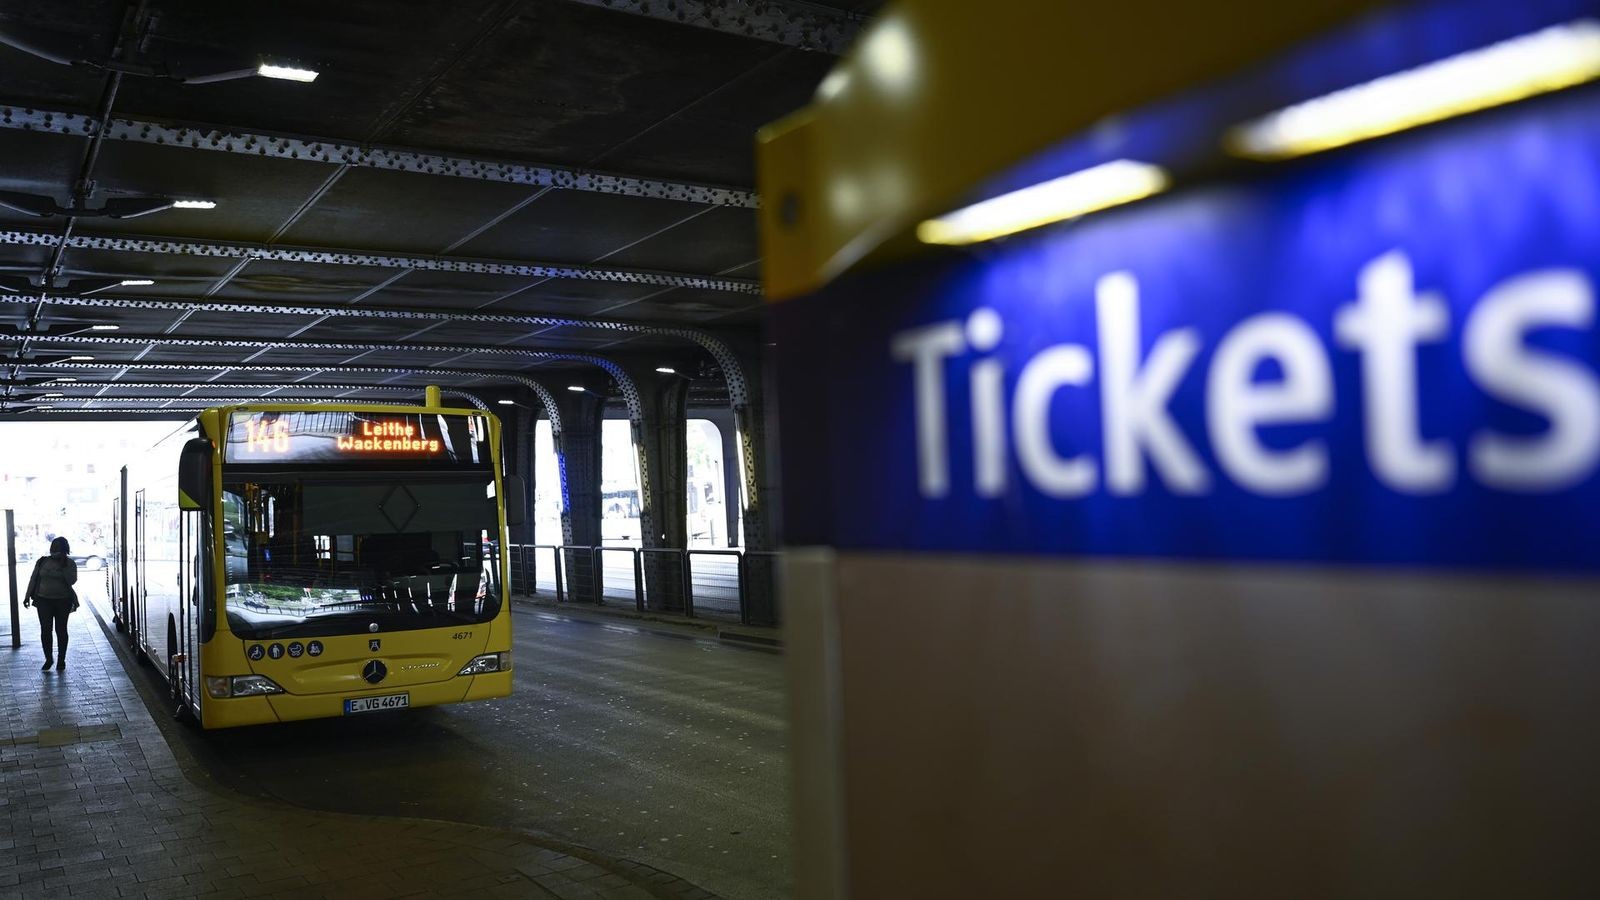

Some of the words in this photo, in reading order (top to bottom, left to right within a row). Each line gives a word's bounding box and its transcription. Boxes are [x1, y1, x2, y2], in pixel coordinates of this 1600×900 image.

[893, 250, 1600, 499] Tickets
[245, 419, 289, 453] 146
[363, 421, 414, 436] Leithe
[337, 436, 440, 452] Wackenberg
[452, 631, 473, 640] 4671
[382, 695, 408, 708] 4671
